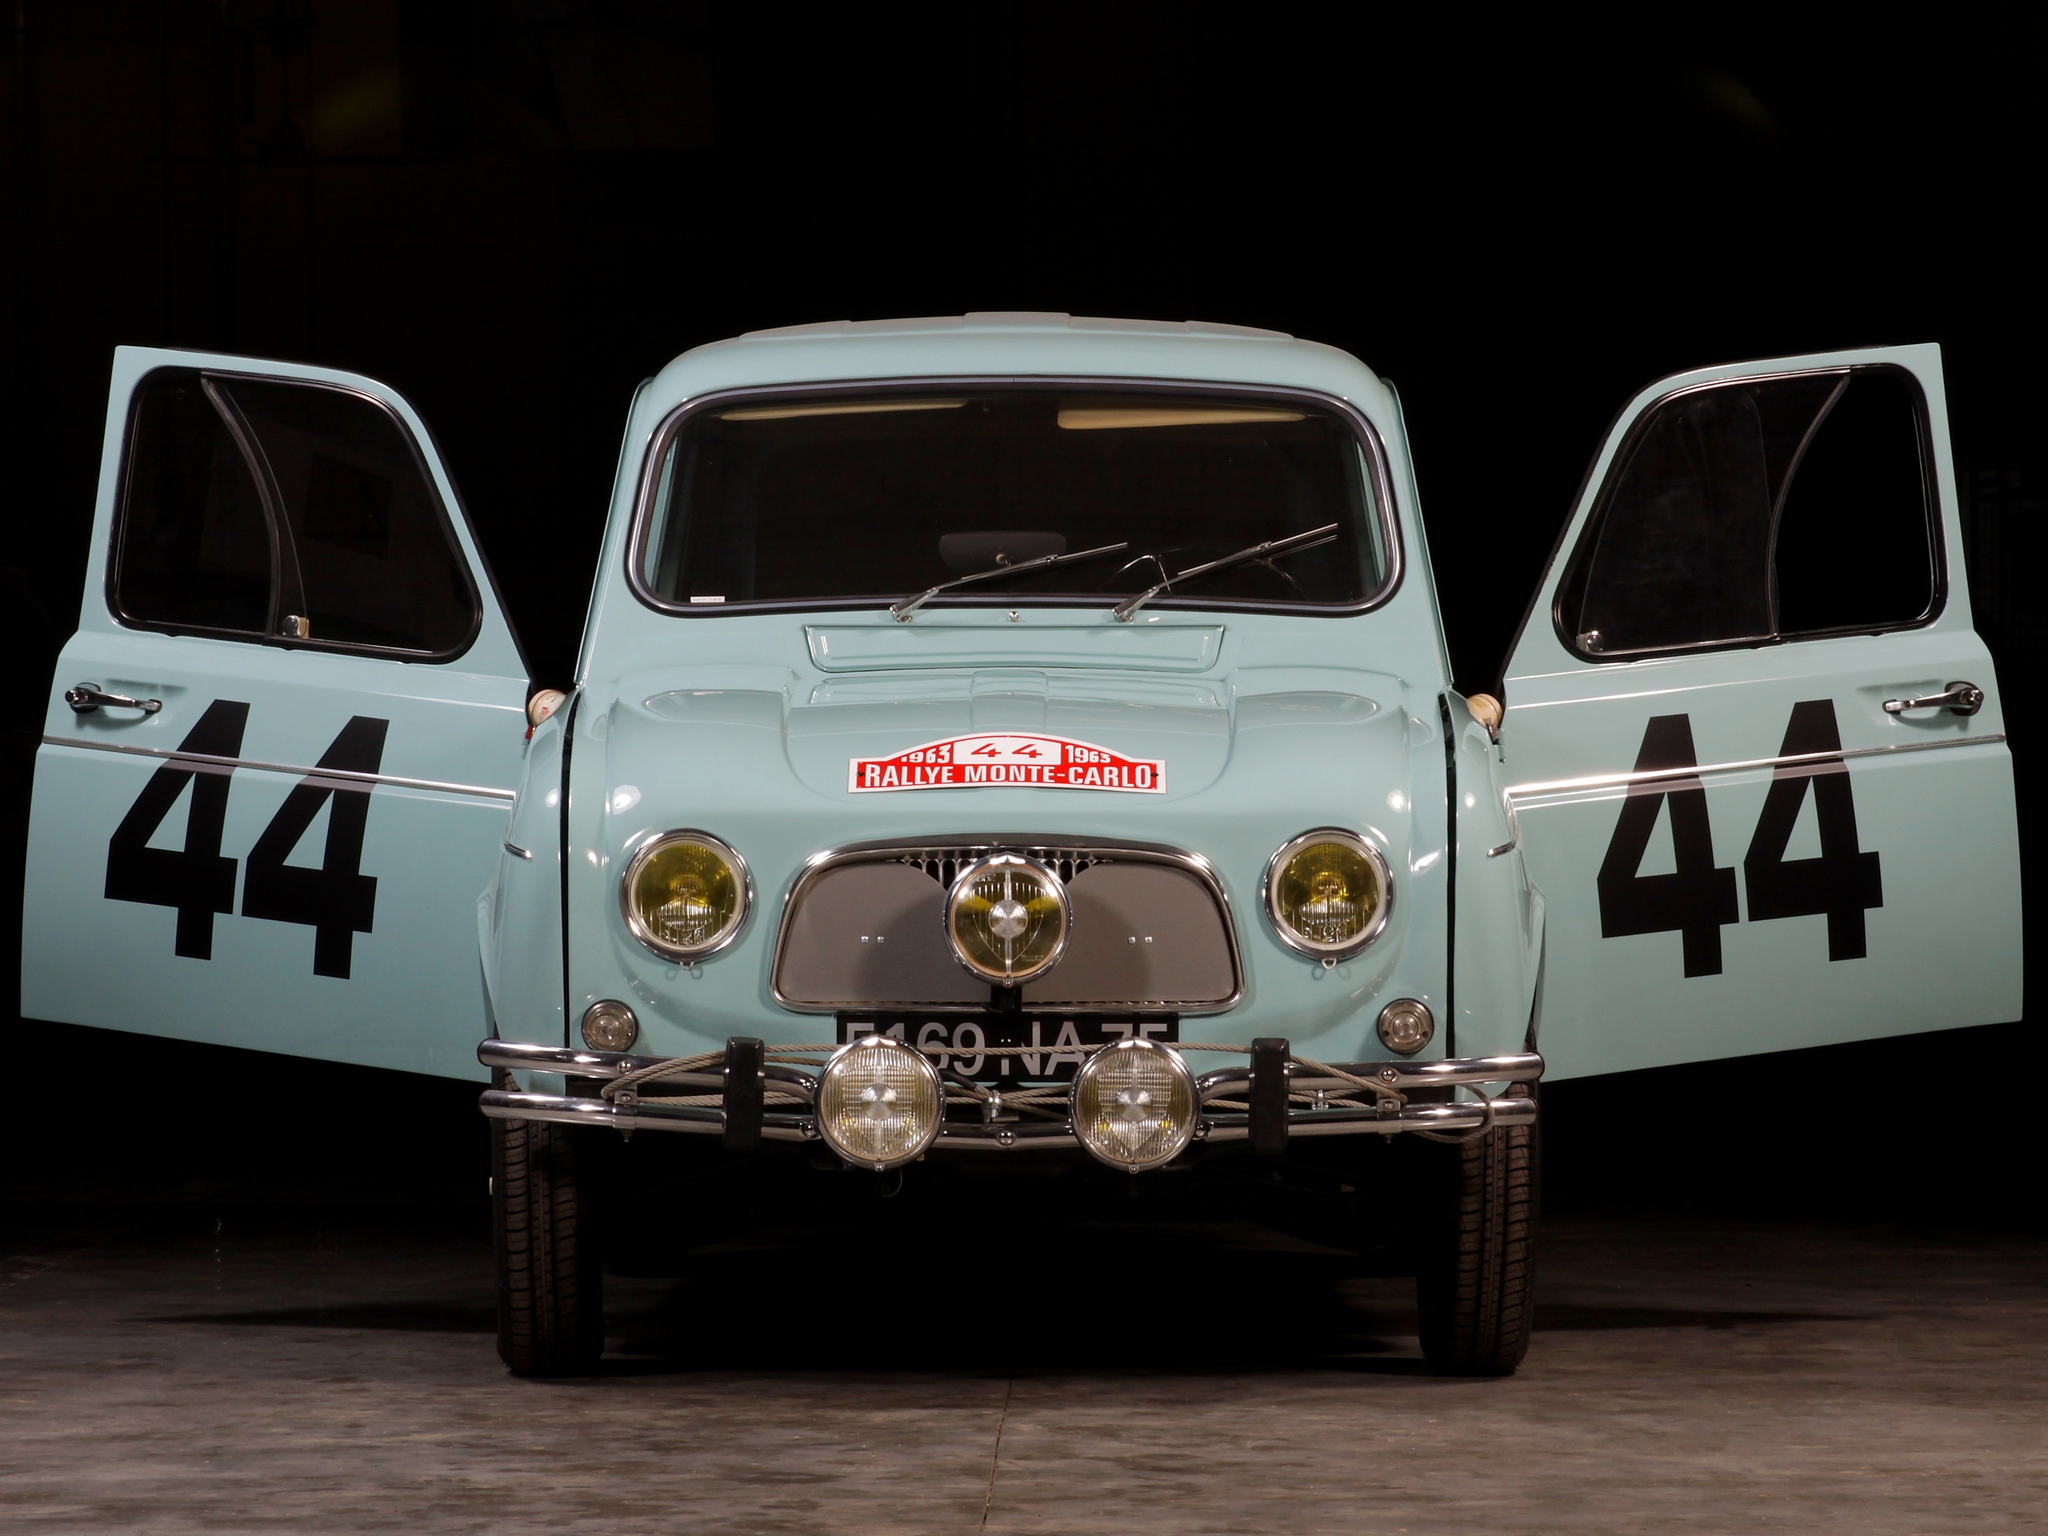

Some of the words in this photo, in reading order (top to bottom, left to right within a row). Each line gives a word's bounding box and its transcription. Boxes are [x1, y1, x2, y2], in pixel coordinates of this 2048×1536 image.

[865, 764, 954, 787] RALLYE
[964, 765, 1151, 788] MONTE-CARLO
[970, 742, 1043, 758] 44
[1065, 744, 1111, 763] 1963
[104, 699, 390, 979] 44
[1597, 698, 1883, 978] 44
